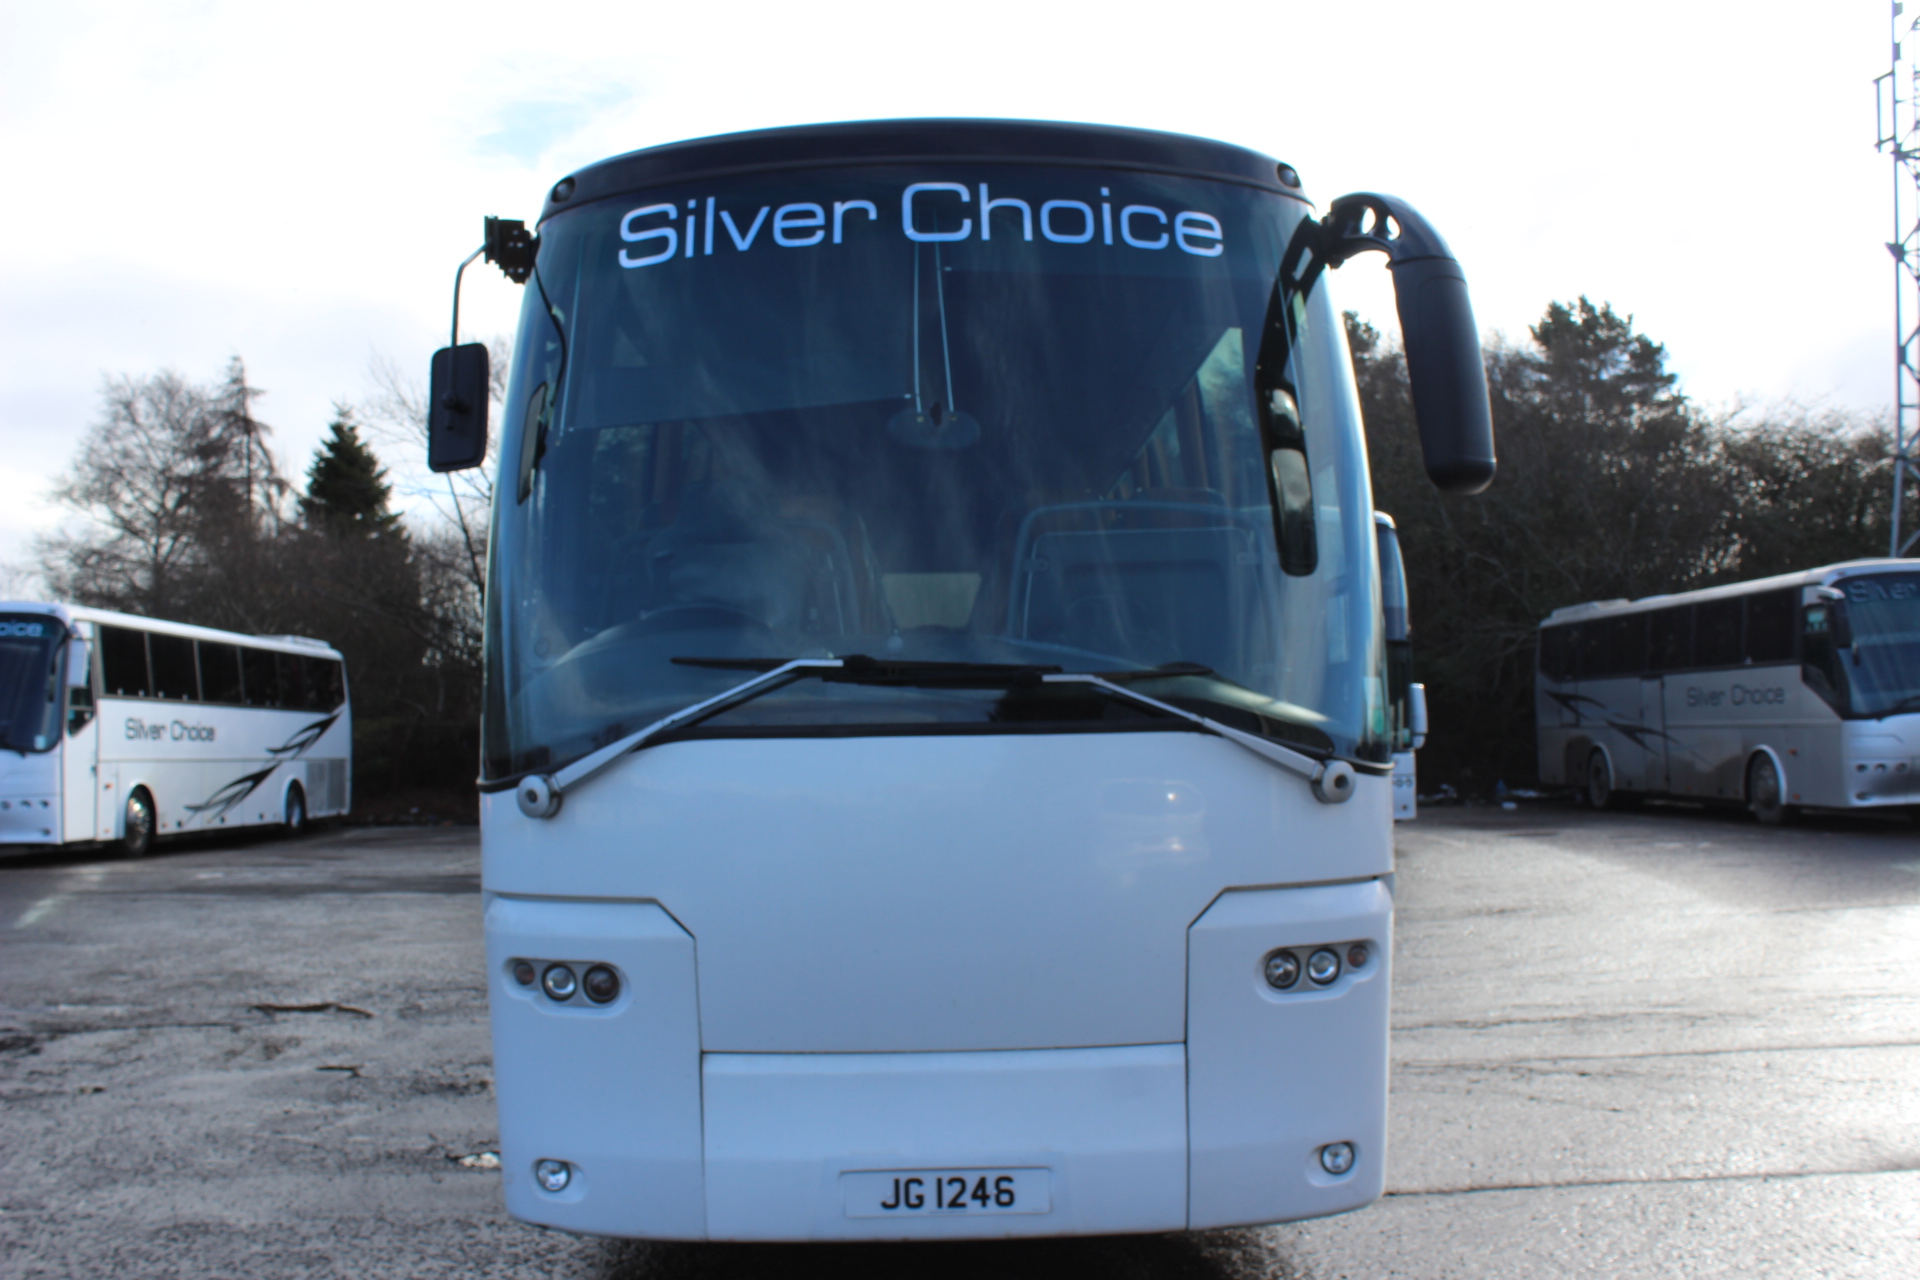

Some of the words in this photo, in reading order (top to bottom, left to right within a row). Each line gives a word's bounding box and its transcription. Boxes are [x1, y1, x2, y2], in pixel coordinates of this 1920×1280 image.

[618, 195, 877, 269] Silver
[901, 182, 1225, 257] Choice
[125, 717, 166, 740] Silver
[171, 719, 216, 742] Choice
